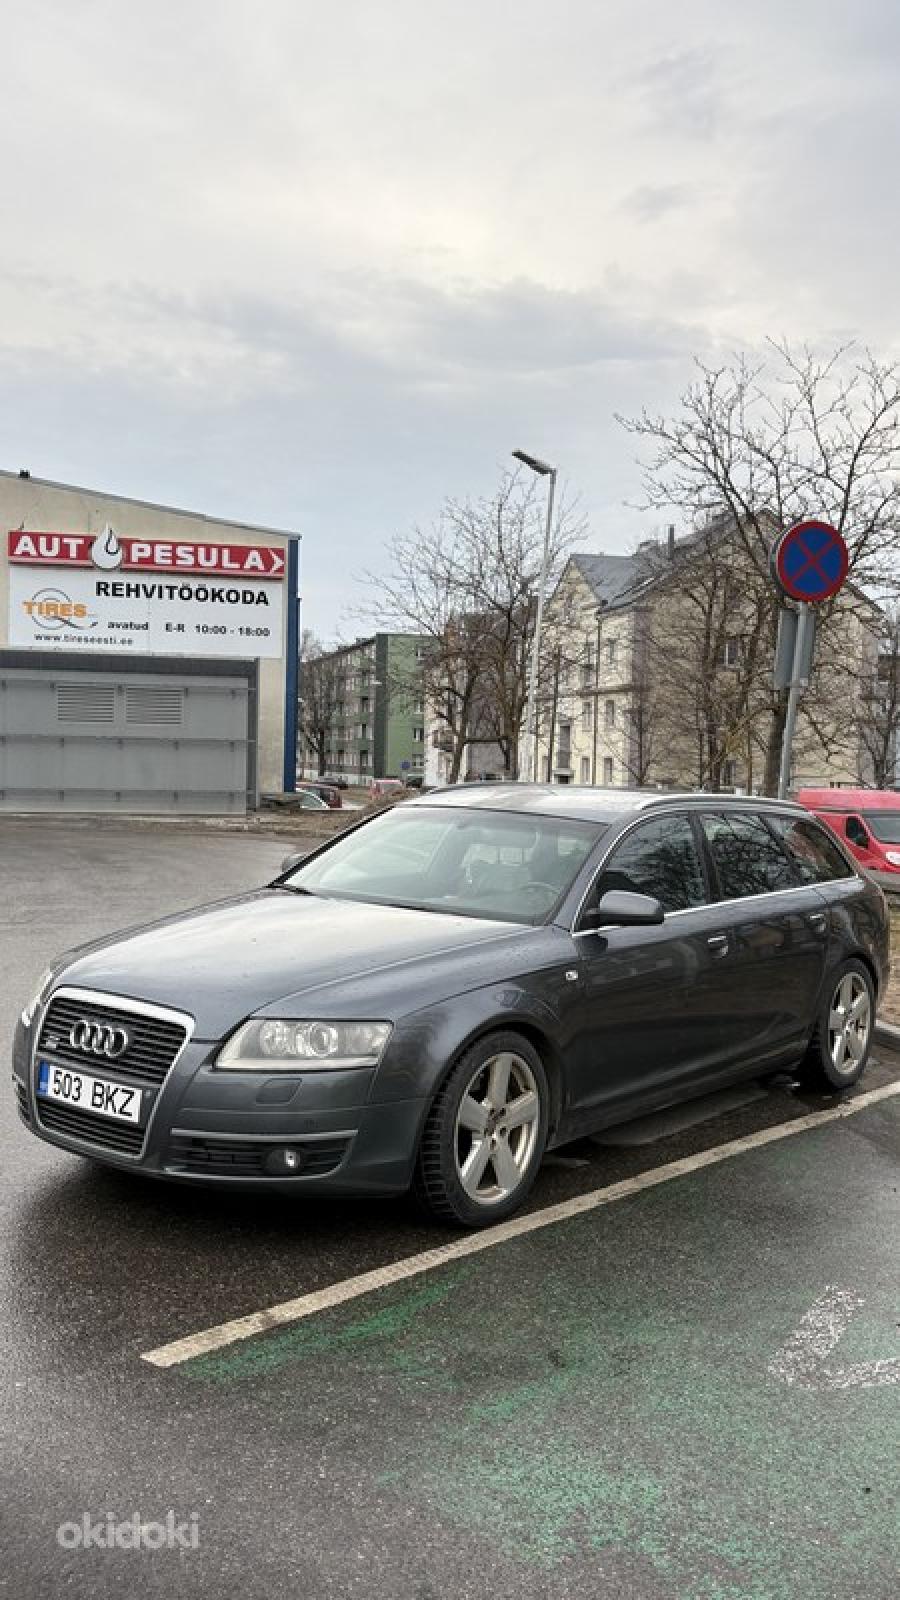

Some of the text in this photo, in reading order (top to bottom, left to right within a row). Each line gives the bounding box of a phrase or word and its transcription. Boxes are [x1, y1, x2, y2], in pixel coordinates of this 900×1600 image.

[95, 581, 269, 606] REHVITÖÖKODA
[22, 601, 88, 618] TIRES
[107, 621, 149, 631] avatud
[165, 622, 185, 633] E-R
[195, 624, 227, 635] 10:00
[238, 627, 270, 637] 18:00
[34, 634, 133, 645] www.tireseesti.ee
[53, 1069, 135, 1117] 503 BKZ
